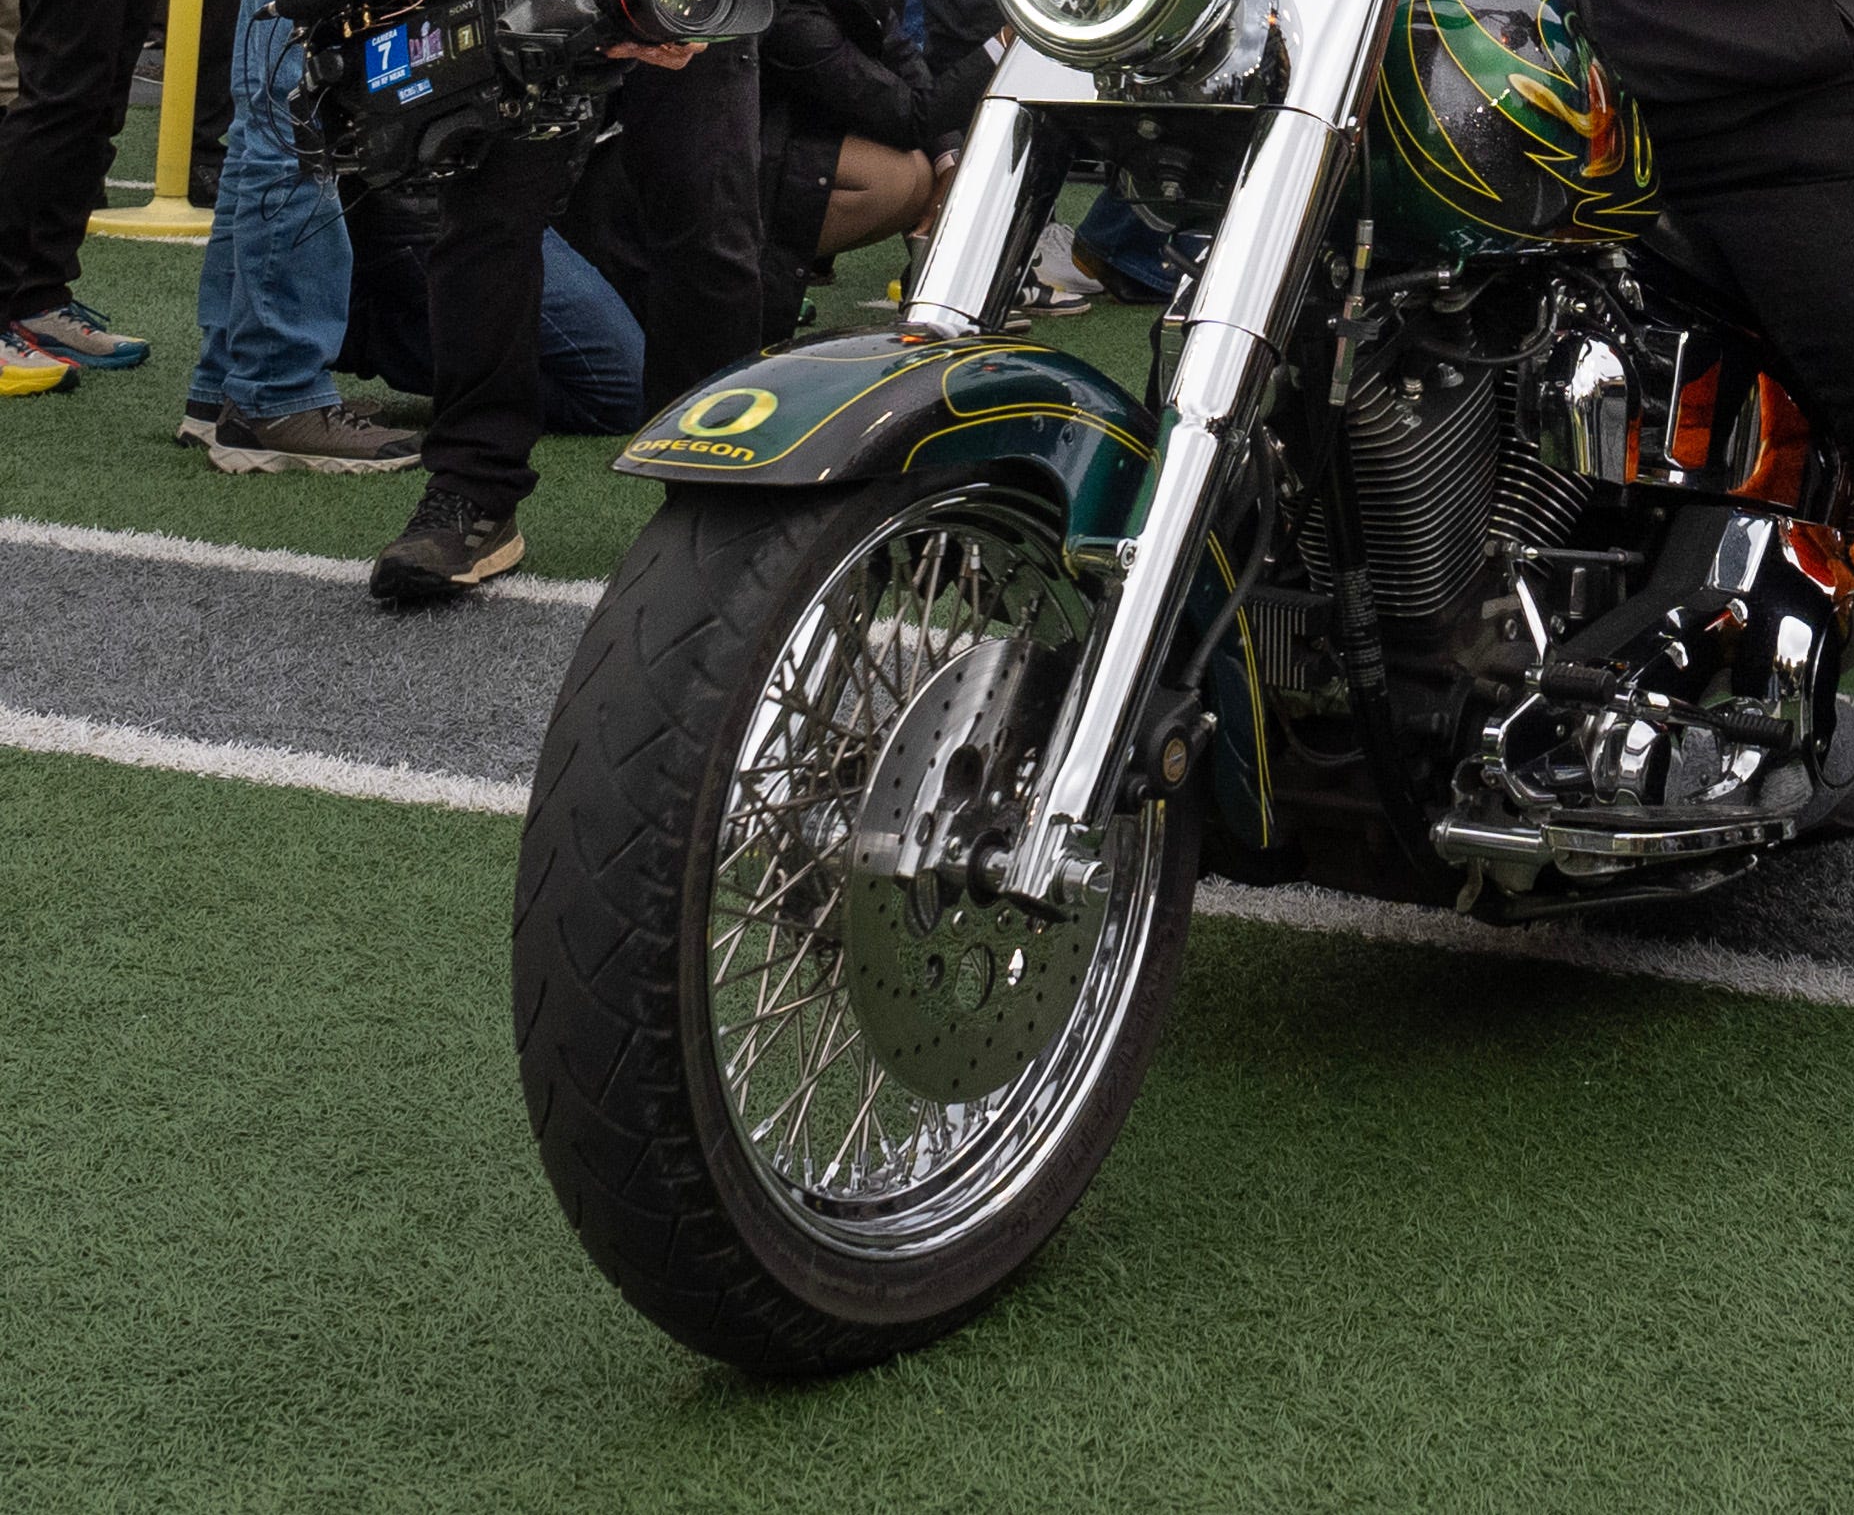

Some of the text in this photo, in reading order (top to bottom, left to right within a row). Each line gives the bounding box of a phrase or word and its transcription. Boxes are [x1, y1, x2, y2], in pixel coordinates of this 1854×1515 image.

[449, 0, 476, 17] SONY
[378, 41, 392, 70] 7
[678, 387, 779, 438] O
[632, 440, 755, 462] OREGON
